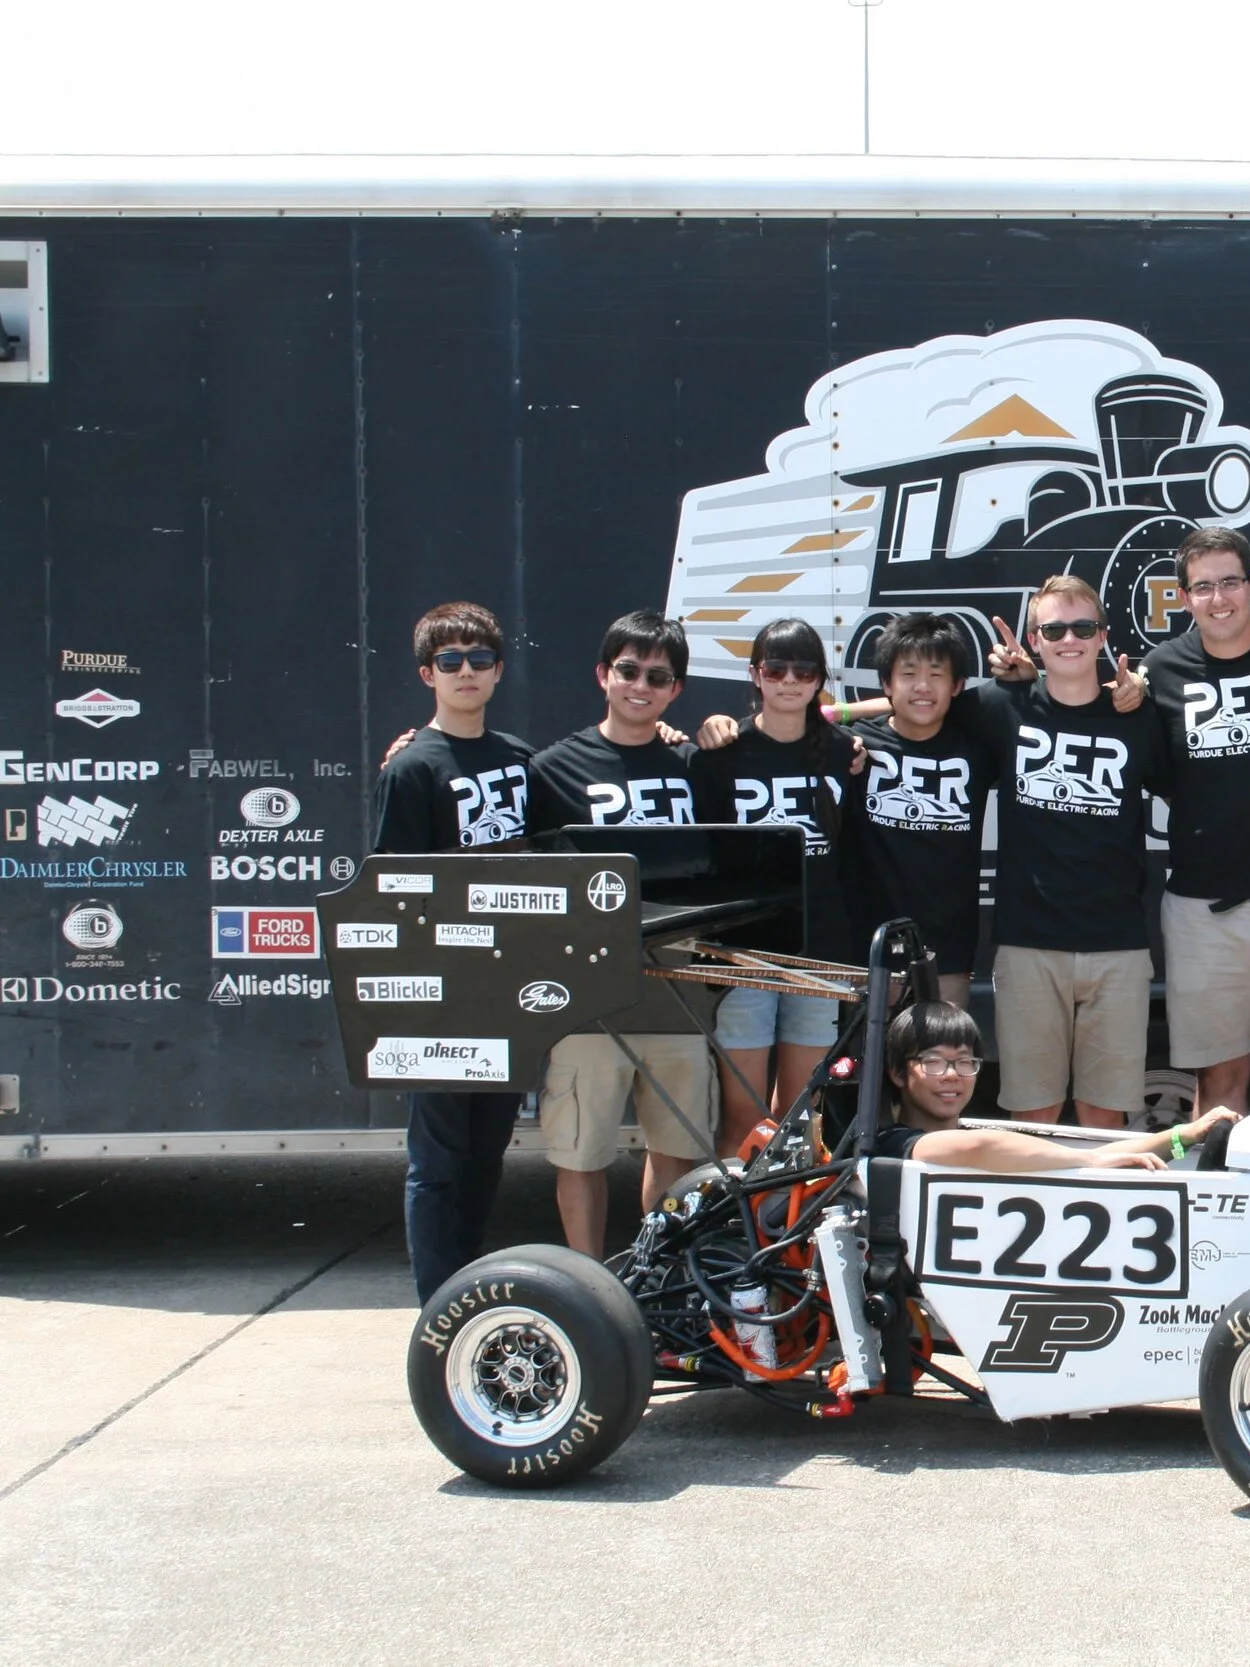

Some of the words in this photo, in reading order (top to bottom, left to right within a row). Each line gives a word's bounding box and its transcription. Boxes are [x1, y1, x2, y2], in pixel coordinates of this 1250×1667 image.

[61, 650, 127, 666] PURDUE
[1016, 725, 1128, 790] PER
[1188, 748, 1223, 759] PURDUE
[314, 759, 352, 777] Inc.
[867, 749, 970, 804] PER
[587, 778, 695, 825] PER
[1047, 802, 1088, 814] ELECTRIC
[1090, 807, 1119, 816] RACING
[898, 821, 939, 831] ELECTRIC
[942, 822, 971, 831] RACING
[219, 830, 278, 842] DEXTER
[284, 829, 325, 842] AXLE
[210, 855, 321, 881] BOSCH
[396, 876, 432, 885] VICOR
[490, 890, 560, 911] JUSTRITE
[258, 919, 304, 933] FORD
[441, 926, 490, 937] HITACHI
[252, 934, 310, 946] TRUCKS
[351, 930, 394, 943] TDK
[33, 976, 181, 1001] Dometic
[377, 981, 440, 999] Blickle
[522, 985, 567, 1010] Gates
[423, 1041, 479, 1059] DIRECT
[374, 1052, 421, 1075] soga
[464, 1069, 506, 1079] ProAxis
[1216, 1194, 1250, 1213] TE
[934, 1193, 1177, 1285] E223
[421, 1280, 515, 1356] Hoosier
[1139, 1304, 1180, 1325] Zook
[978, 1293, 1126, 1374] P
[1143, 1350, 1184, 1364] epec
[507, 1401, 603, 1475] Hoosier
